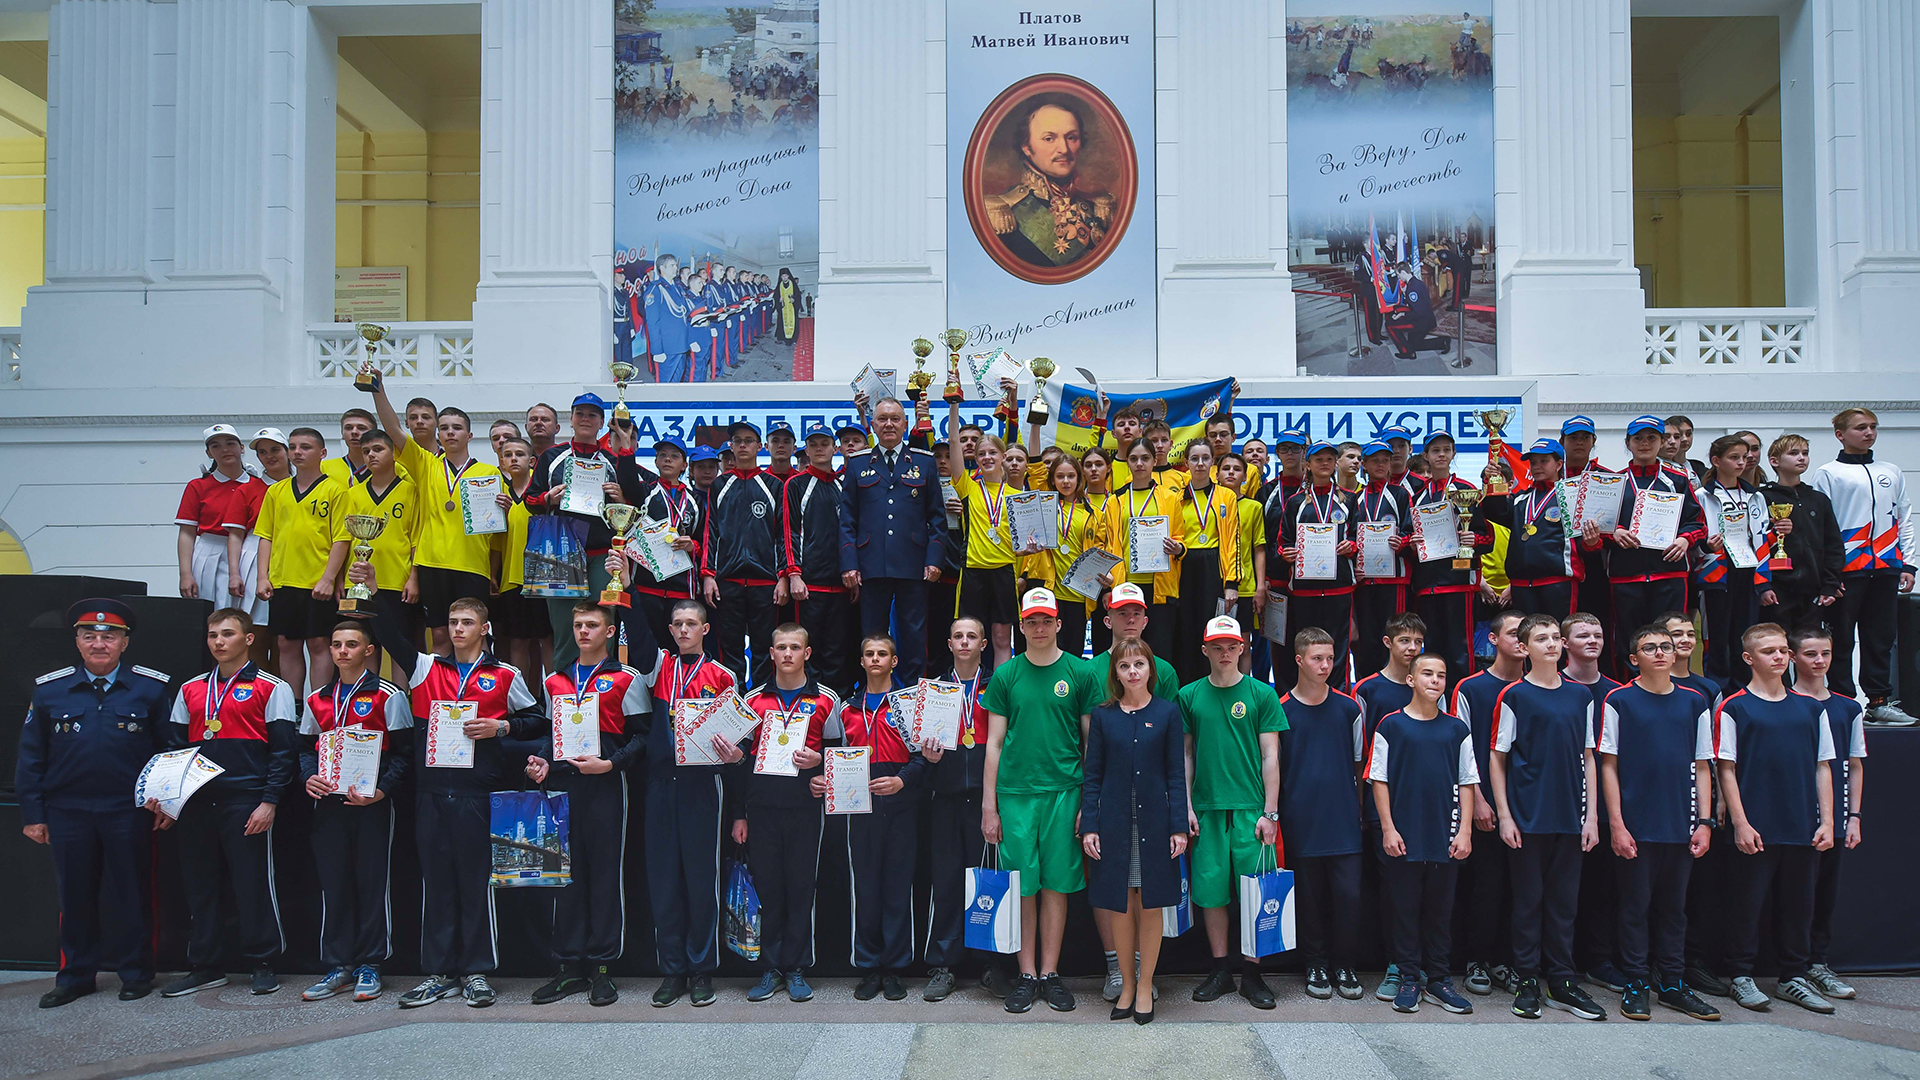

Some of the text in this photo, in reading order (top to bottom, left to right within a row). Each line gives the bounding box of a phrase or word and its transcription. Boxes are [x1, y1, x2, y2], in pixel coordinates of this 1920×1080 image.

[1018, 11, 1082, 25] Платов
[971, 33, 1130, 48] Матвей Иванович
[1316, 125, 1468, 175] За Веру, Дон
[627, 143, 807, 197] Верны традициям
[1339, 159, 1462, 204] и Отечество
[656, 176, 793, 222] вольного Дона
[968, 298, 1137, 347] Вихрь-Атаман
[1231, 412, 1311, 440] ОЛИ
[1327, 412, 1353, 439] И
[310, 498, 330, 518] 13
[391, 502, 404, 519] 6
[1646, 507, 1674, 515] ГРАМОТА
[1424, 517, 1450, 526] ГРАМОТА
[928, 699, 956, 708] ГРАМОТА
[721, 709, 742, 732] ГРАМОТА
